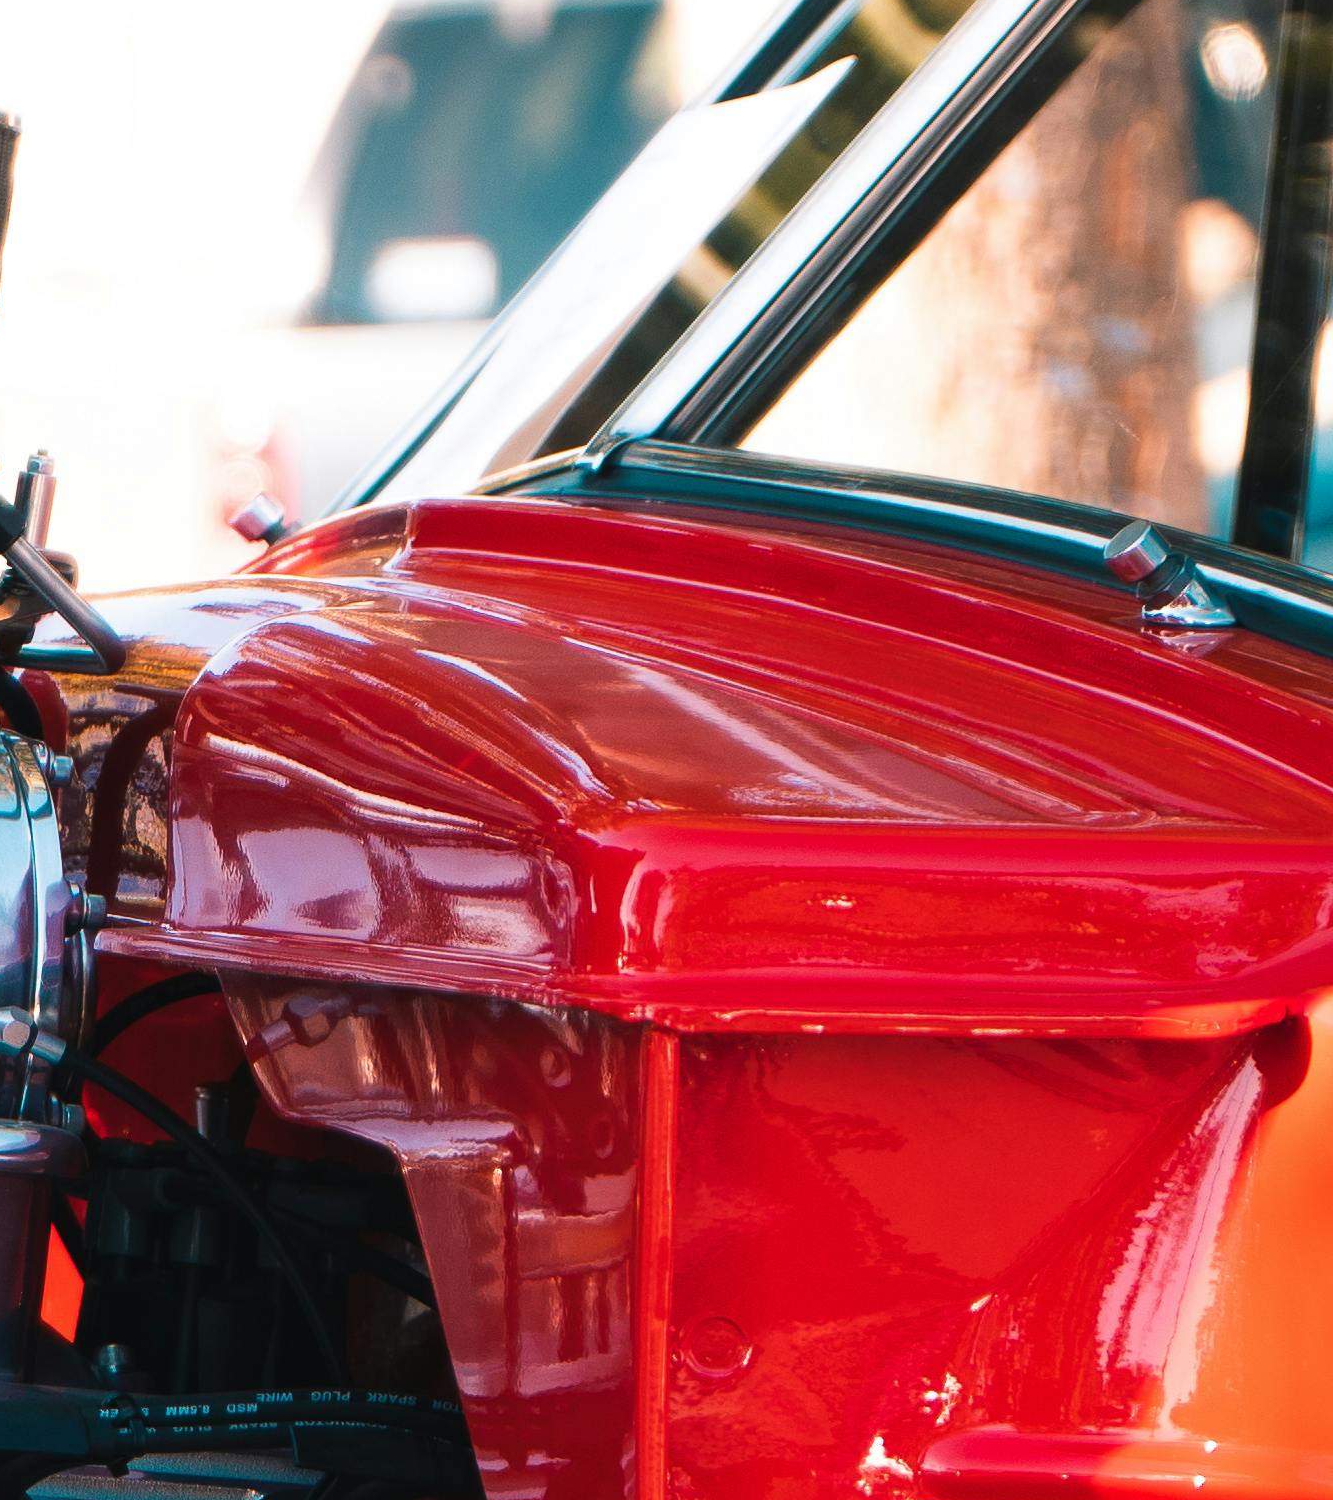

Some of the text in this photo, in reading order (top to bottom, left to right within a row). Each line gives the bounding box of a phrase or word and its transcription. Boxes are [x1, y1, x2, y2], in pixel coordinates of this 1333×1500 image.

[255, 1391, 294, 1404] WIRE
[310, 1390, 351, 1403] PLUG
[366, 1391, 418, 1406] SPARK
[226, 1402, 259, 1417] MSD
